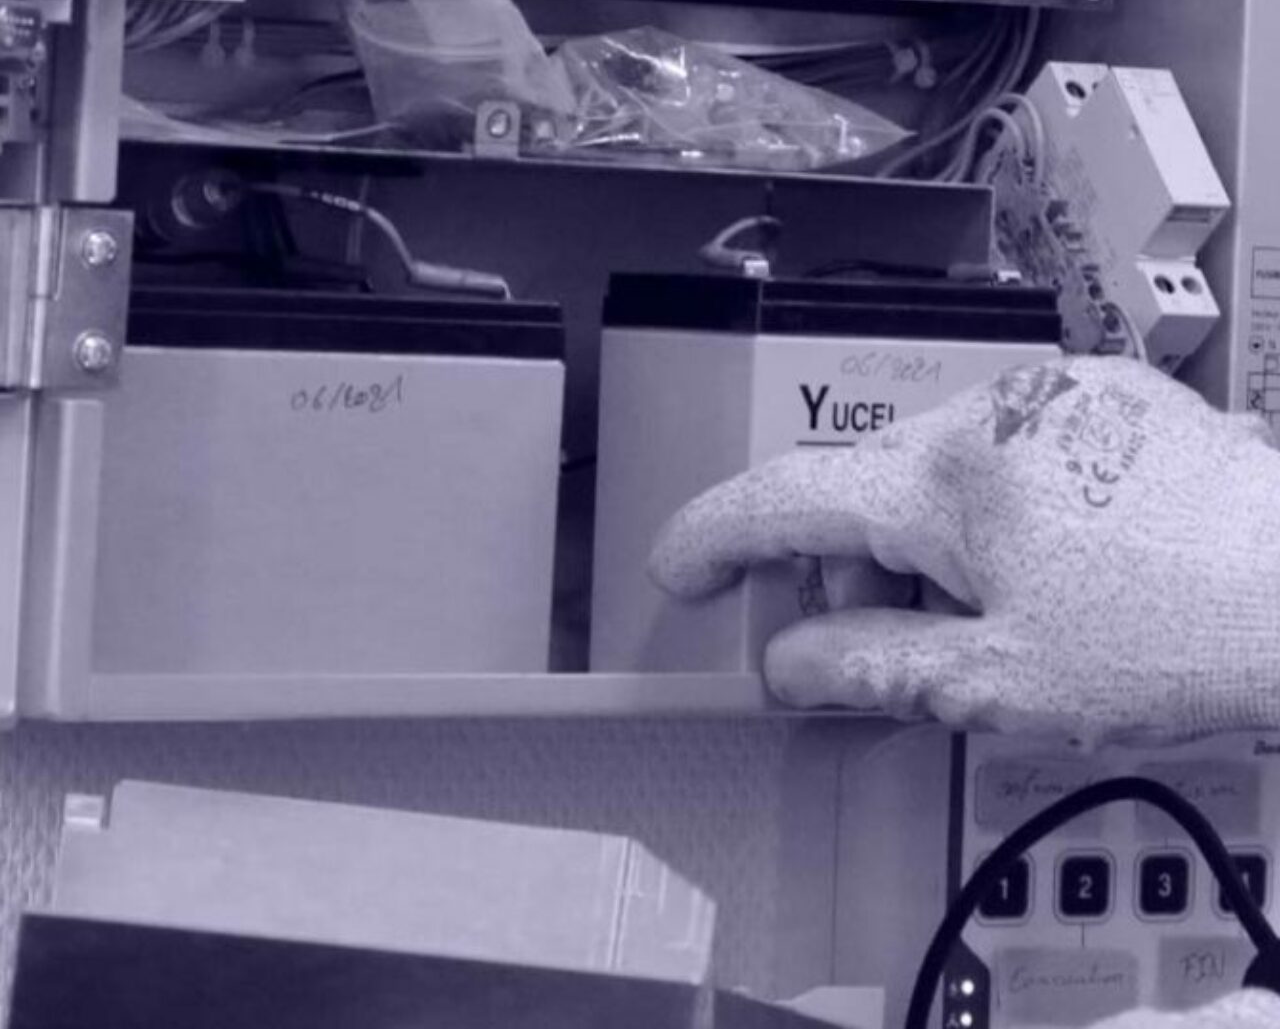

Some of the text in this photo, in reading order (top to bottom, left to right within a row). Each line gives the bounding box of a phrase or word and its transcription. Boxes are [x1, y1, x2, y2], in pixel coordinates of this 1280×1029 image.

[999, 878, 1010, 900] 1
[1077, 874, 1094, 899] 2
[1157, 872, 1173, 898] 3
